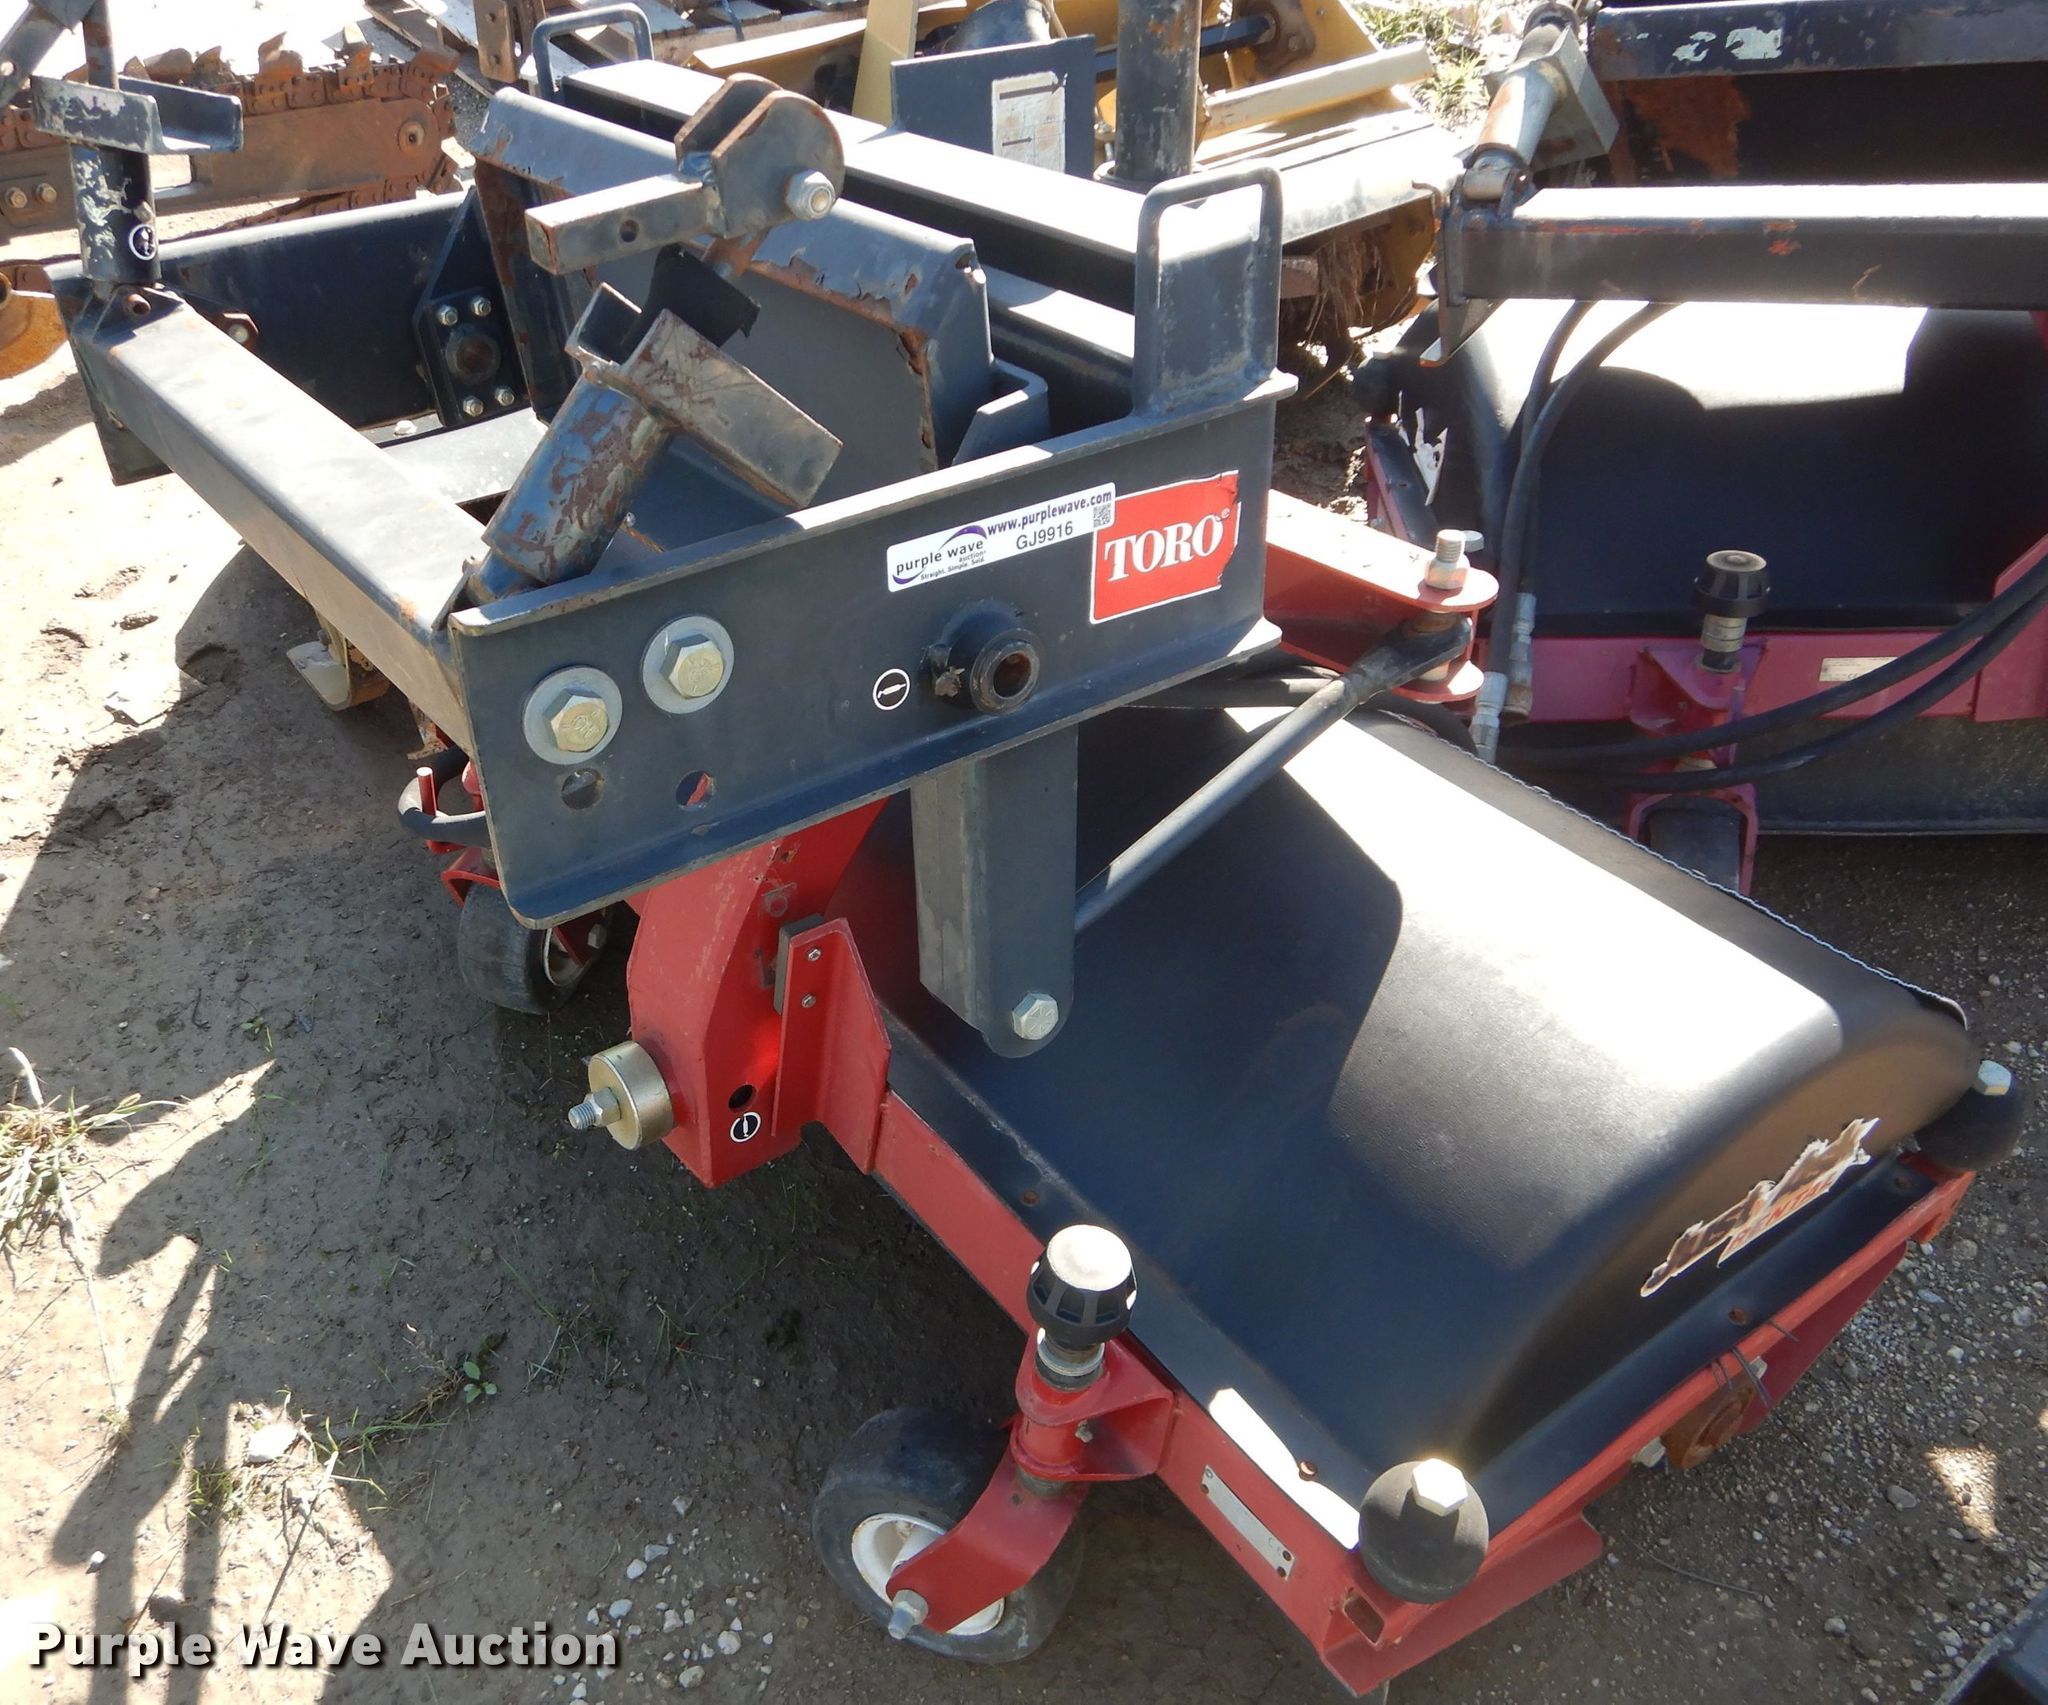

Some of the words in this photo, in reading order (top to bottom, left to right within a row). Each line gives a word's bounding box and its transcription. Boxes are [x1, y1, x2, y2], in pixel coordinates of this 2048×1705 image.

[987, 491, 1112, 536] www.purplewave.com
[1016, 520, 1074, 550] GJ9916
[1104, 514, 1223, 582] TORO
[896, 551, 942, 576] purple
[947, 540, 984, 559] wave
